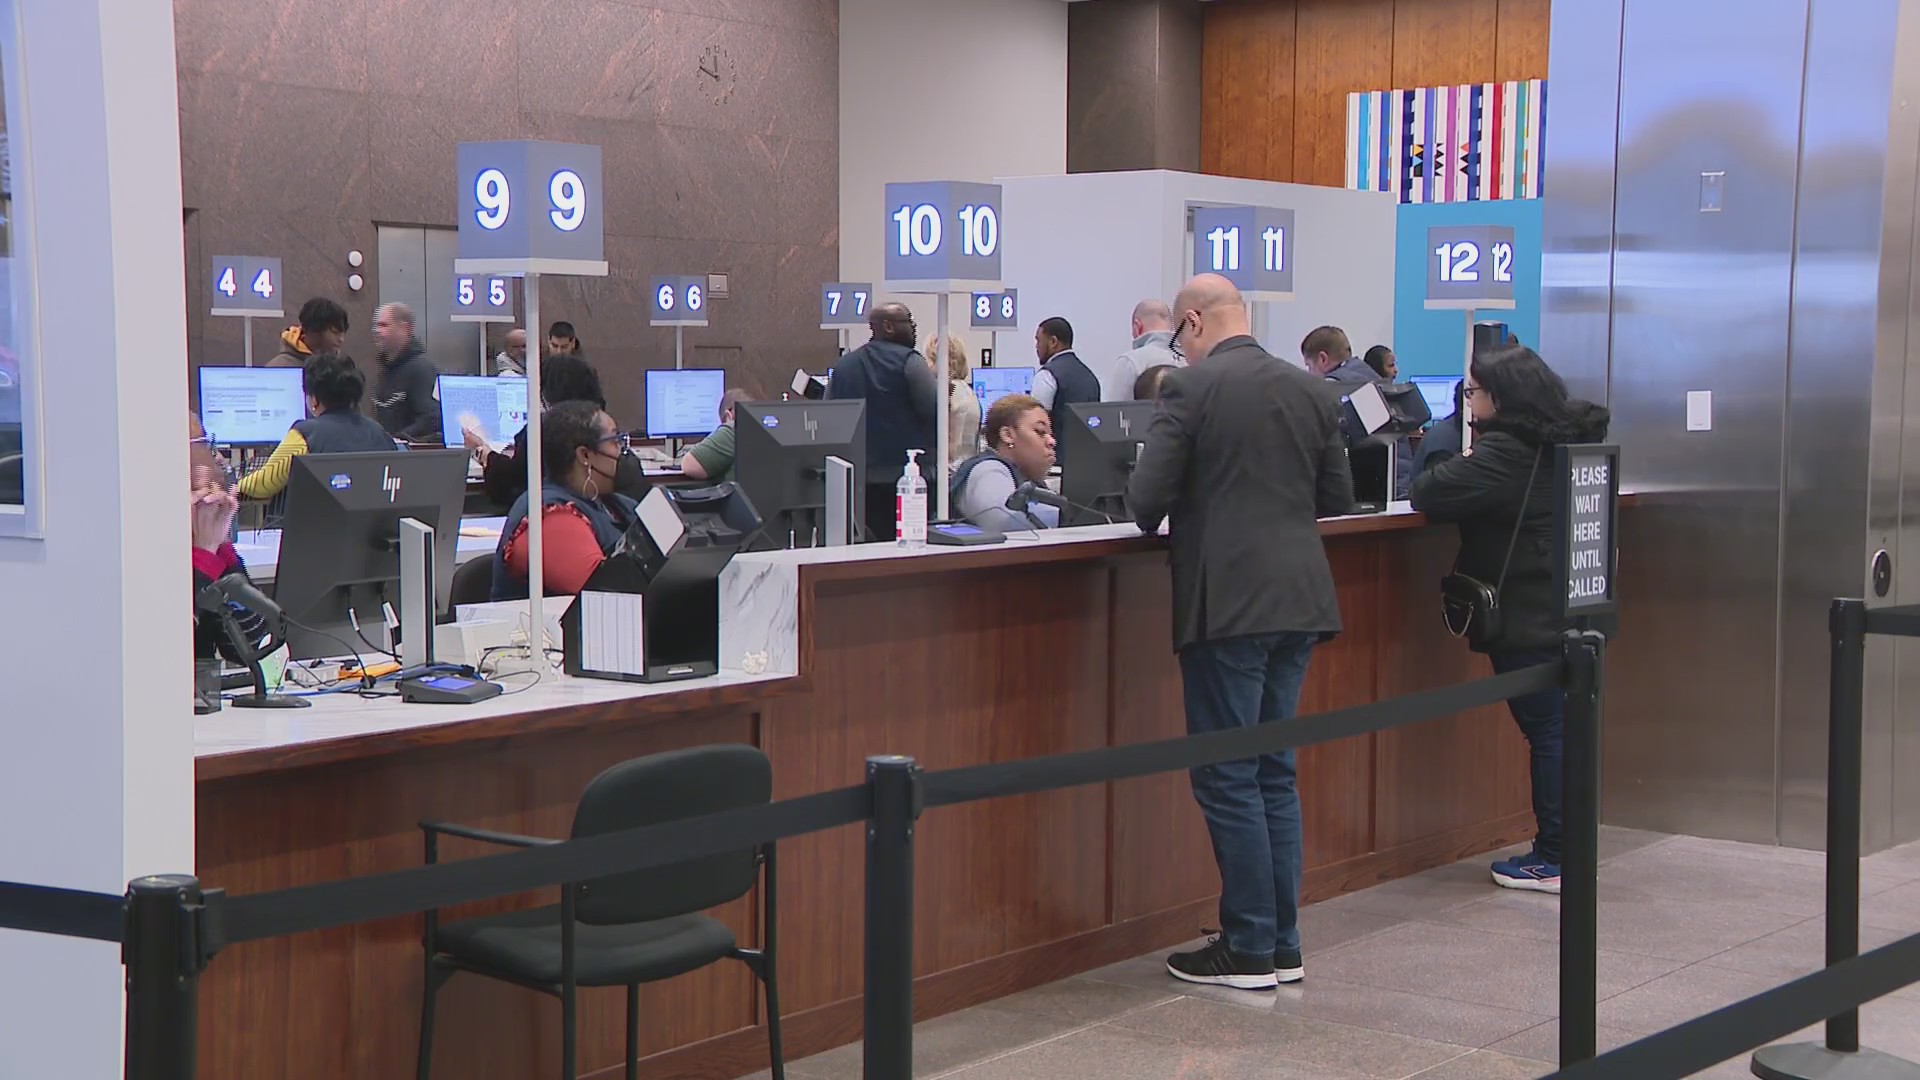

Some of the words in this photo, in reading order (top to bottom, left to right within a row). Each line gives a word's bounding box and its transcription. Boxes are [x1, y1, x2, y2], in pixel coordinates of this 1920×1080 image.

[476, 169, 510, 229] 9
[549, 171, 586, 231] 9
[893, 205, 942, 255] 10
[958, 205, 998, 256] 10
[1207, 226, 1239, 271] 11
[1262, 226, 1284, 271] 11
[1435, 242, 1479, 281] 12
[1491, 242, 1513, 282] 12
[218, 267, 236, 297] 4
[252, 268, 274, 298] 4
[458, 278, 475, 305] 5
[489, 278, 506, 306] 5
[657, 284, 675, 311] 6
[686, 284, 702, 311] 6
[827, 291, 842, 315] 7
[853, 291, 868, 315] 7
[976, 295, 991, 318] 8
[1001, 296, 1014, 319] 8
[803, 410, 818, 441] hp
[382, 464, 402, 503] hp
[1576, 493, 1601, 514] WAIT
[1574, 521, 1601, 543] HERE
[1573, 548, 1602, 571] UNTIL
[1568, 576, 1606, 599] CALLED
